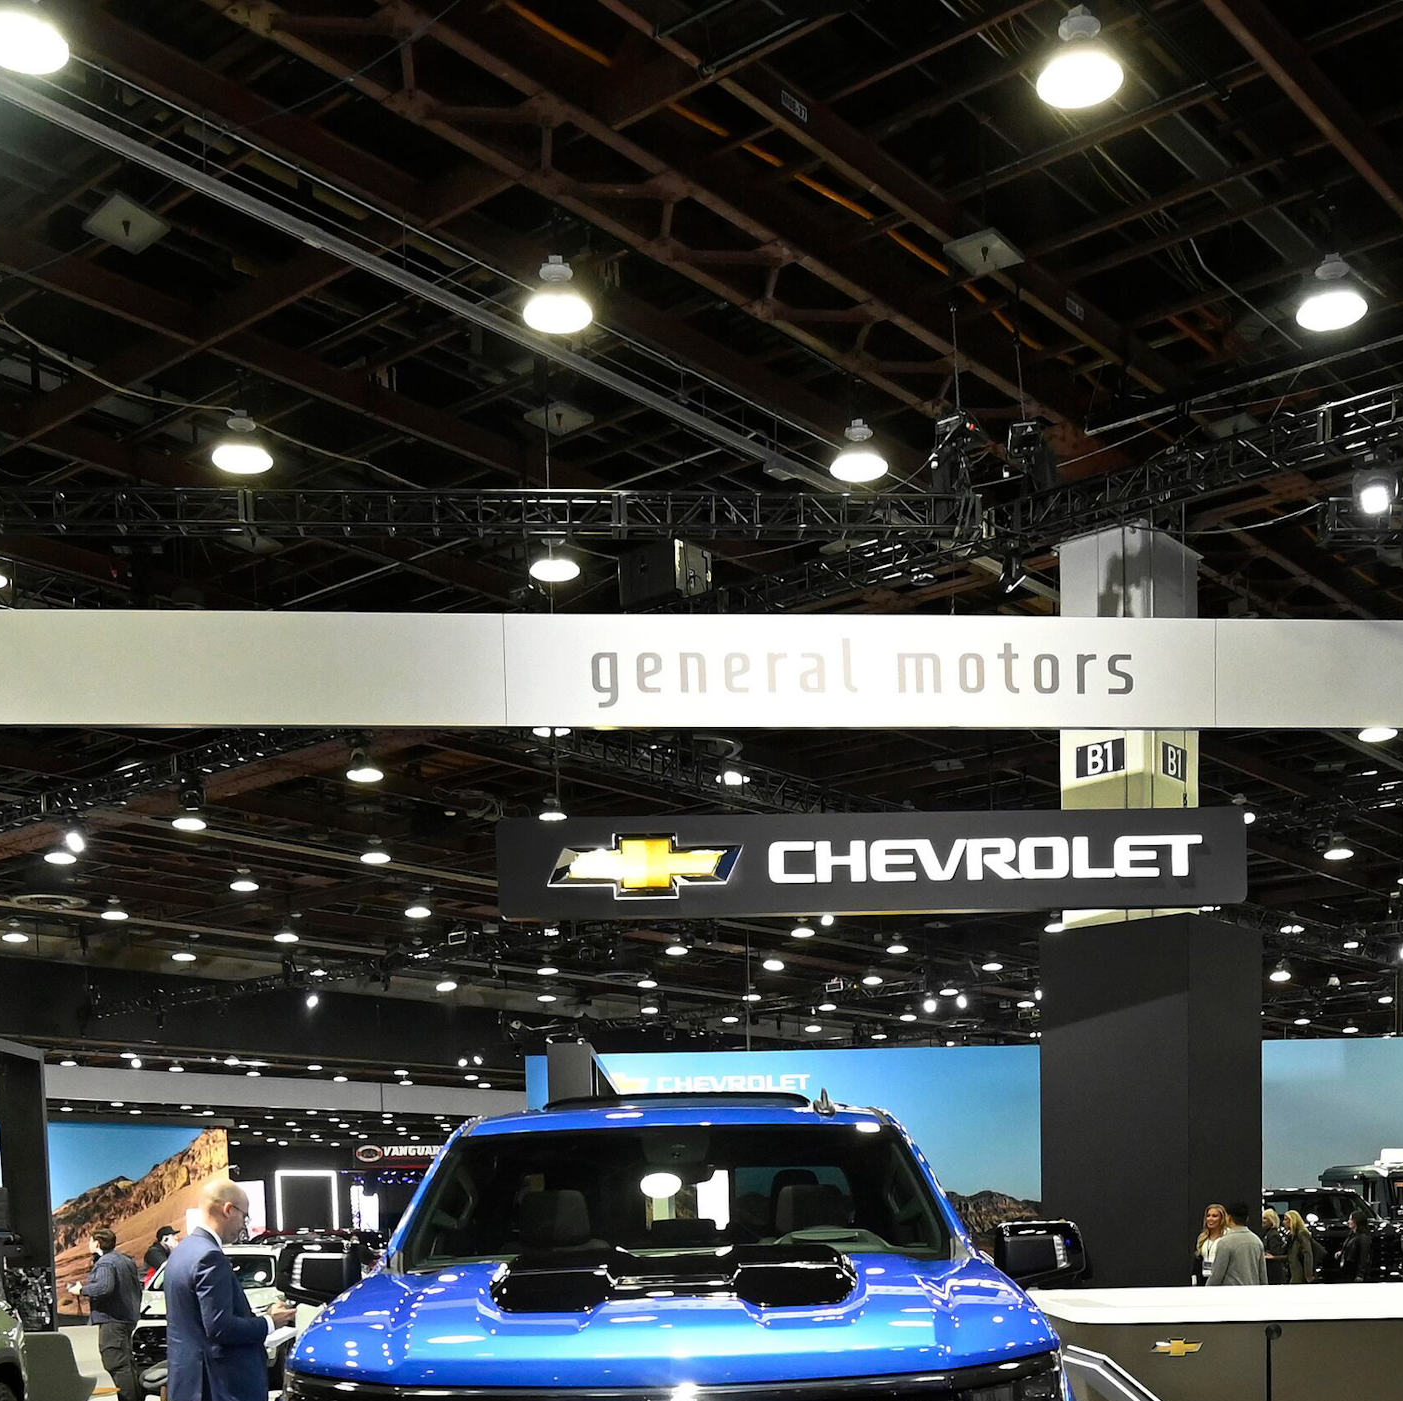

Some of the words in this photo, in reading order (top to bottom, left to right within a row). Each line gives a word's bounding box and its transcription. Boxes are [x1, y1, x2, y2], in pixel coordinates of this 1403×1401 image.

[591, 638, 857, 708] general
[897, 642, 1135, 695] motors
[1087, 741, 1114, 776] B1
[1167, 746, 1182, 779] B1
[768, 833, 1203, 884] CHEVROLET
[656, 1073, 811, 1092] CHEVROLET
[382, 1145, 445, 1157] VANGUAR
